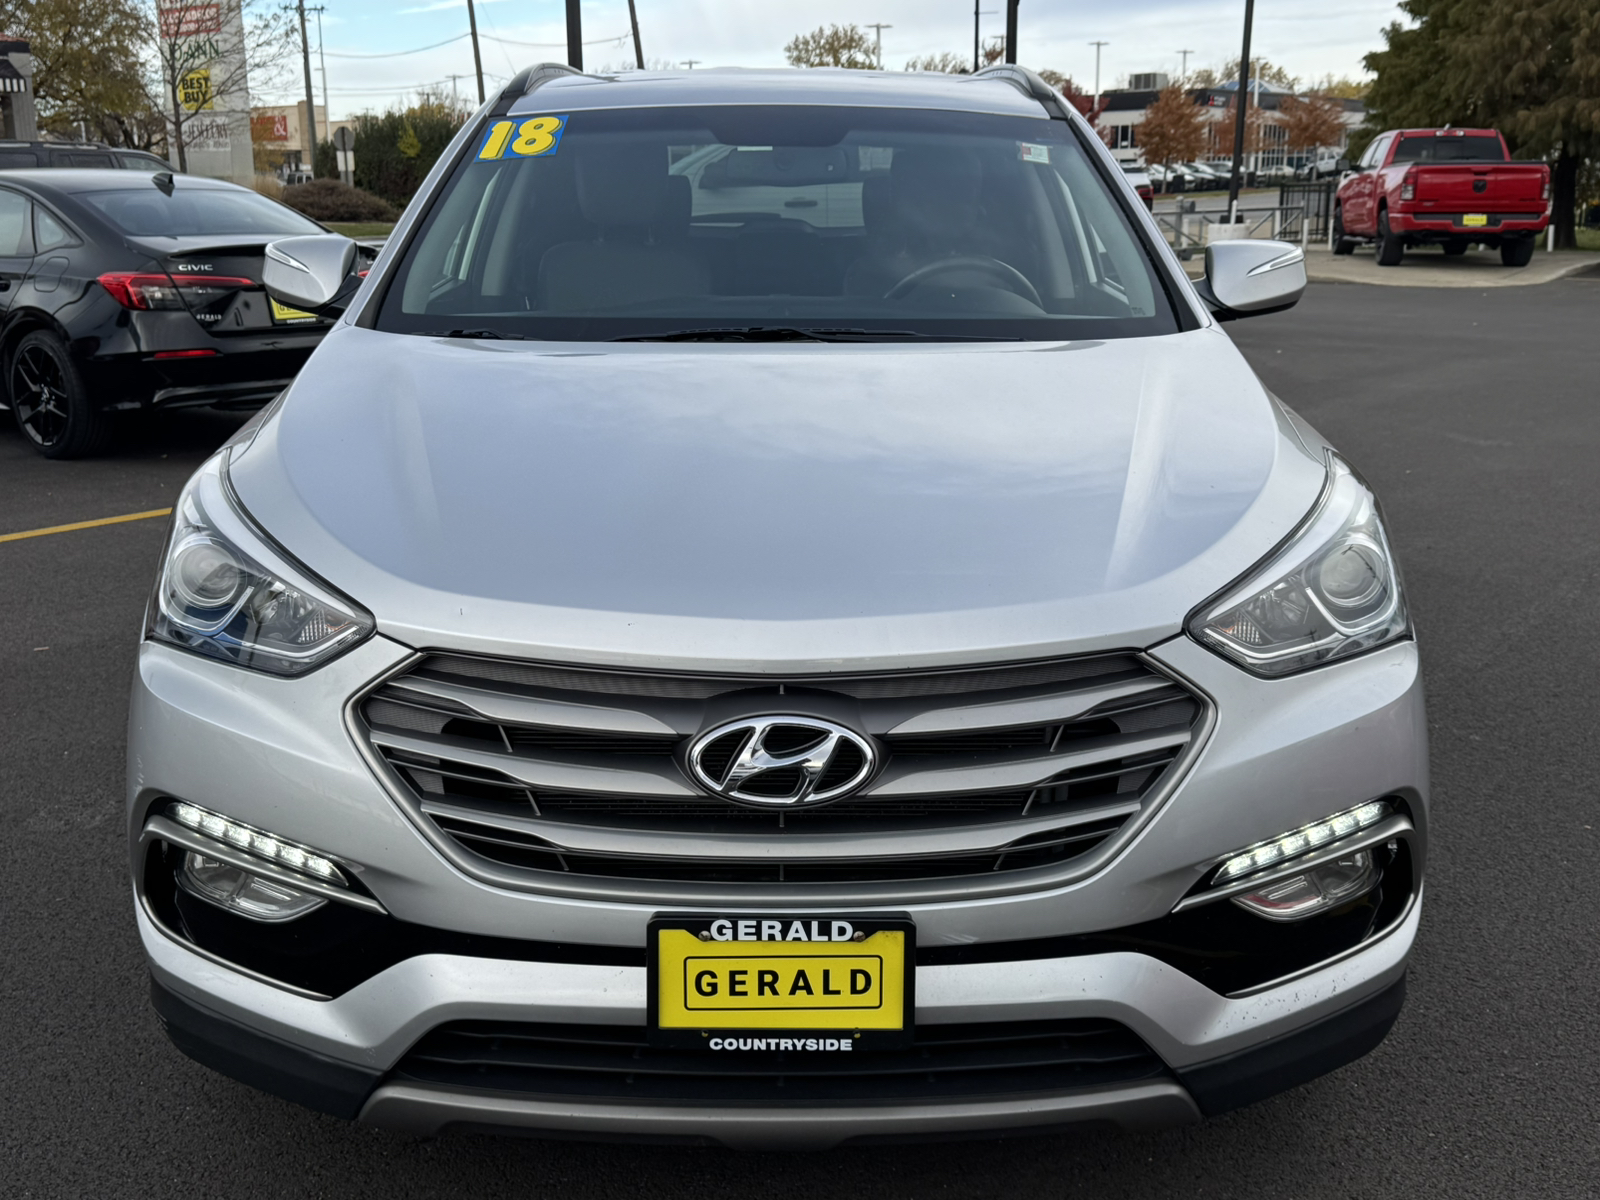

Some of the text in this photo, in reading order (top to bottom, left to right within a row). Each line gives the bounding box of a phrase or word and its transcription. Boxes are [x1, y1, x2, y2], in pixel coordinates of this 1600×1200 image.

[182, 77, 210, 90] BEST
[184, 90, 208, 104] BUY
[478, 116, 562, 160] 18
[709, 919, 854, 942] GERALD
[694, 968, 873, 997] GERALD
[709, 1037, 853, 1051] COUNTRYSIDE
